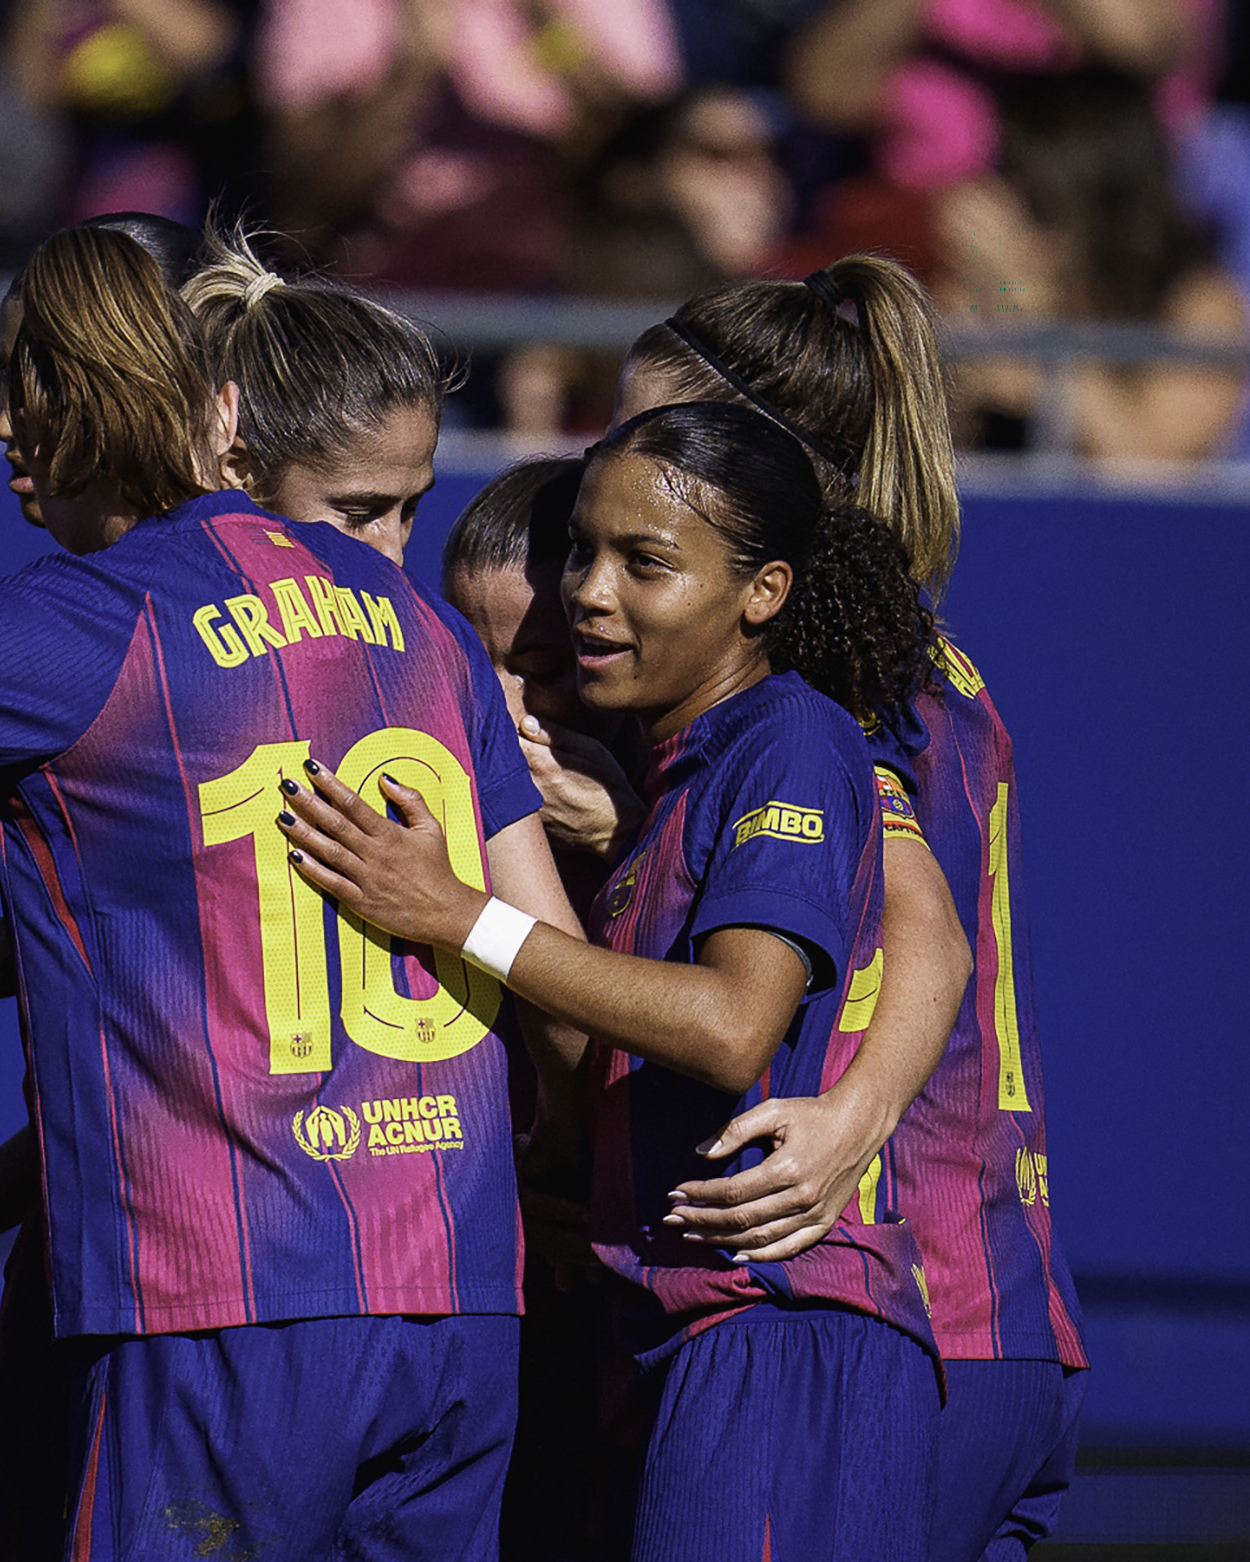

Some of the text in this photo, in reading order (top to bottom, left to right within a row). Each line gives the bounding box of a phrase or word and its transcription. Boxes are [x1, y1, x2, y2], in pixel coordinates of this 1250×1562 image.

[192, 575, 405, 668] GRAHAM
[735, 807, 823, 845] BIMBO
[198, 726, 503, 1075] 10
[362, 1094, 458, 1124] UNHCR
[367, 1117, 463, 1147] ACNUR
[369, 1140, 464, 1156] The UN Refugee Agency
